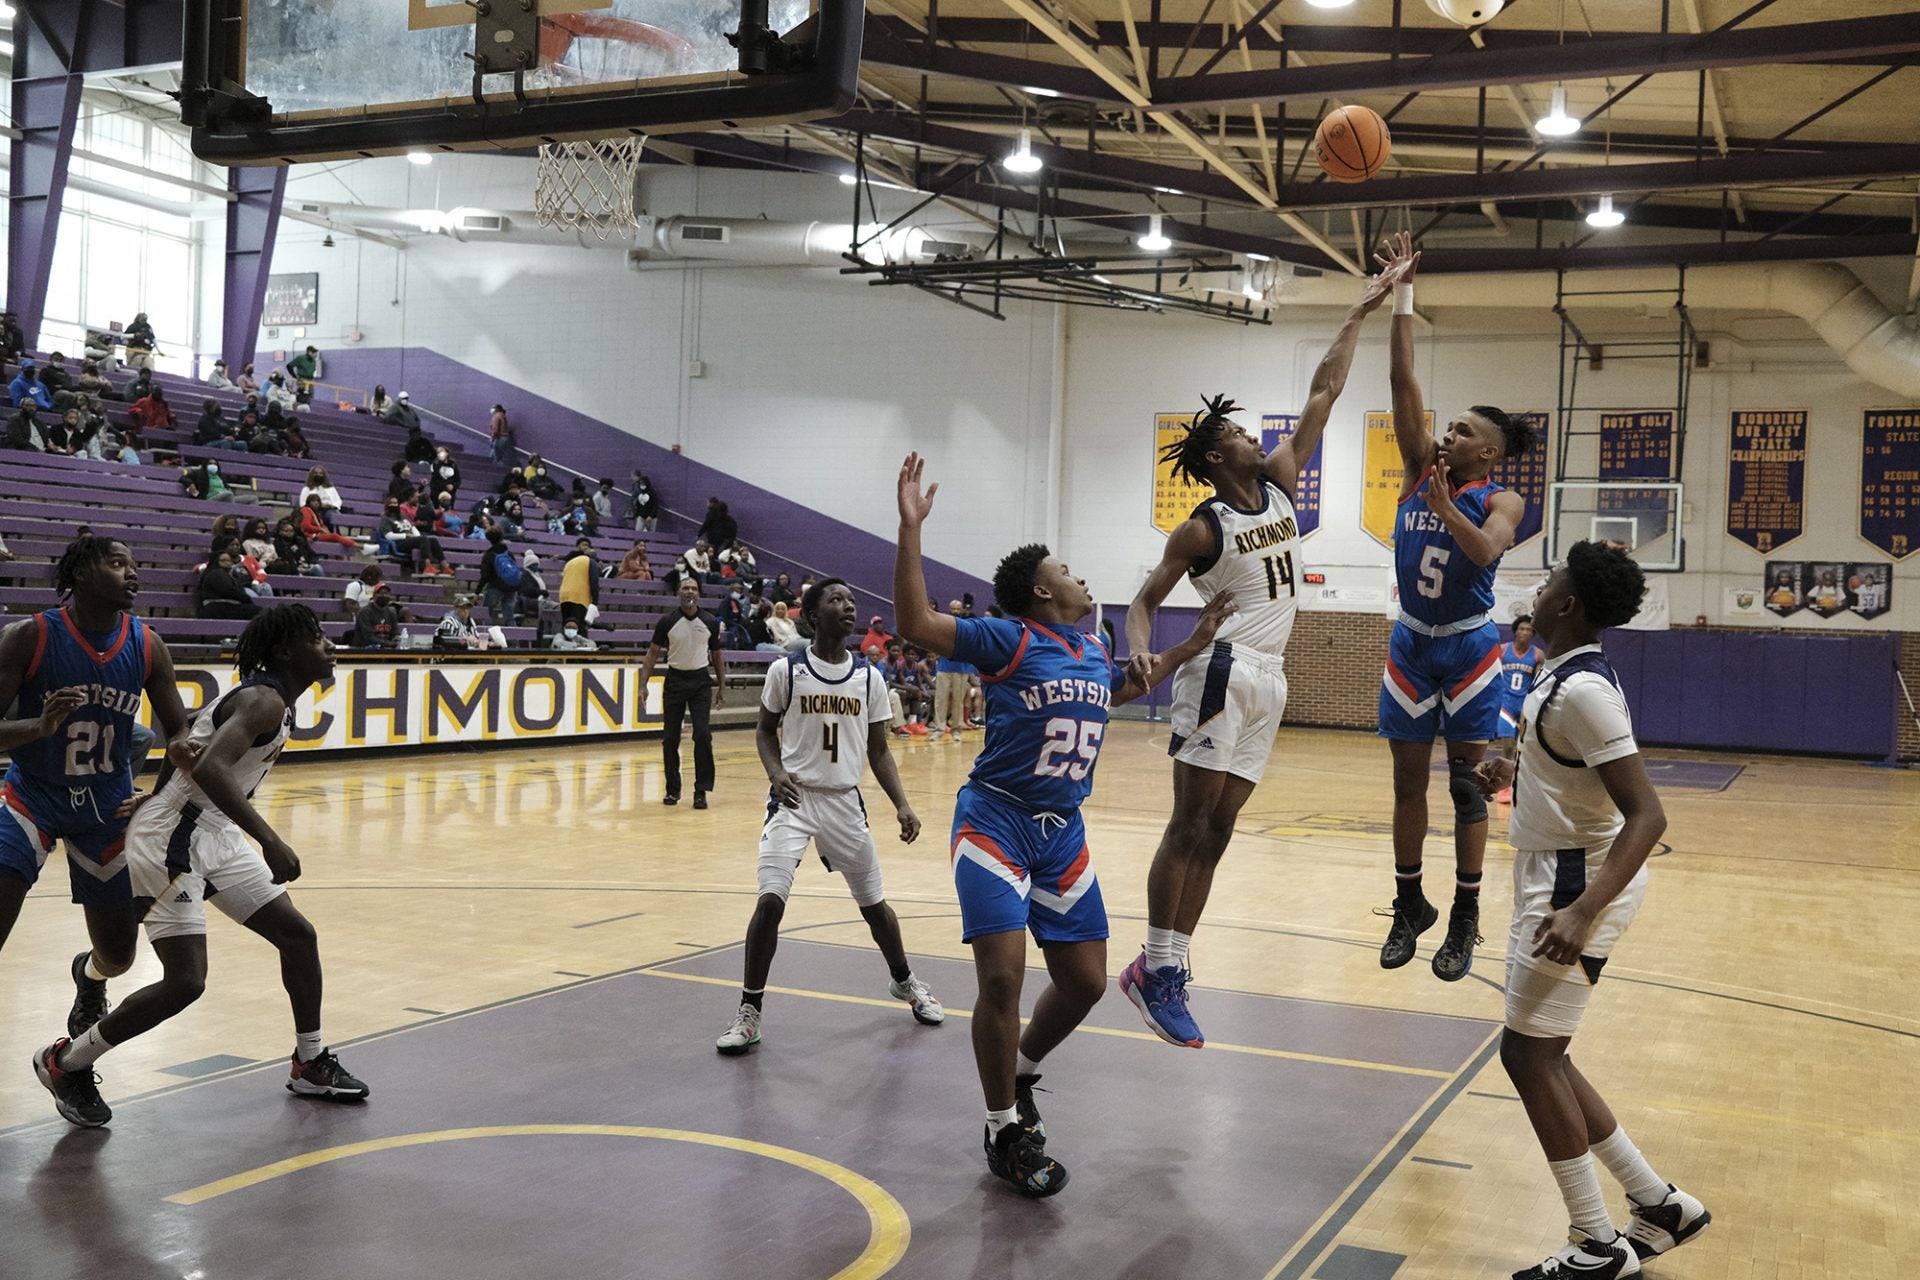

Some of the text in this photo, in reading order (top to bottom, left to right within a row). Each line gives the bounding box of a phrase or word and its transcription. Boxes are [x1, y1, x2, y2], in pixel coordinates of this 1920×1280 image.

[1158, 420, 1181, 430] GIRLS
[1262, 418, 1286, 430] BOYS
[1368, 419, 1395, 429] GIRL
[1603, 415, 1669, 428] BOYS GOLF
[1740, 413, 1803, 425] HONORING
[1736, 425, 1800, 437] OUR PAST
[1886, 432, 1920, 442] STATE
[1751, 438, 1791, 450] STATE
[1731, 450, 1805, 462] CHAMPIONSHIPS
[1884, 471, 1919, 480] REGION
[1235, 516, 1297, 555] RICHMOND
[1261, 550, 1295, 600] 14
[1417, 545, 1451, 599] 5
[1510, 673, 1523, 691] 0
[800, 695, 862, 716] RICHMOND
[822, 721, 839, 763] 4
[65, 721, 115, 776] 21
[1033, 717, 1103, 781] 25
